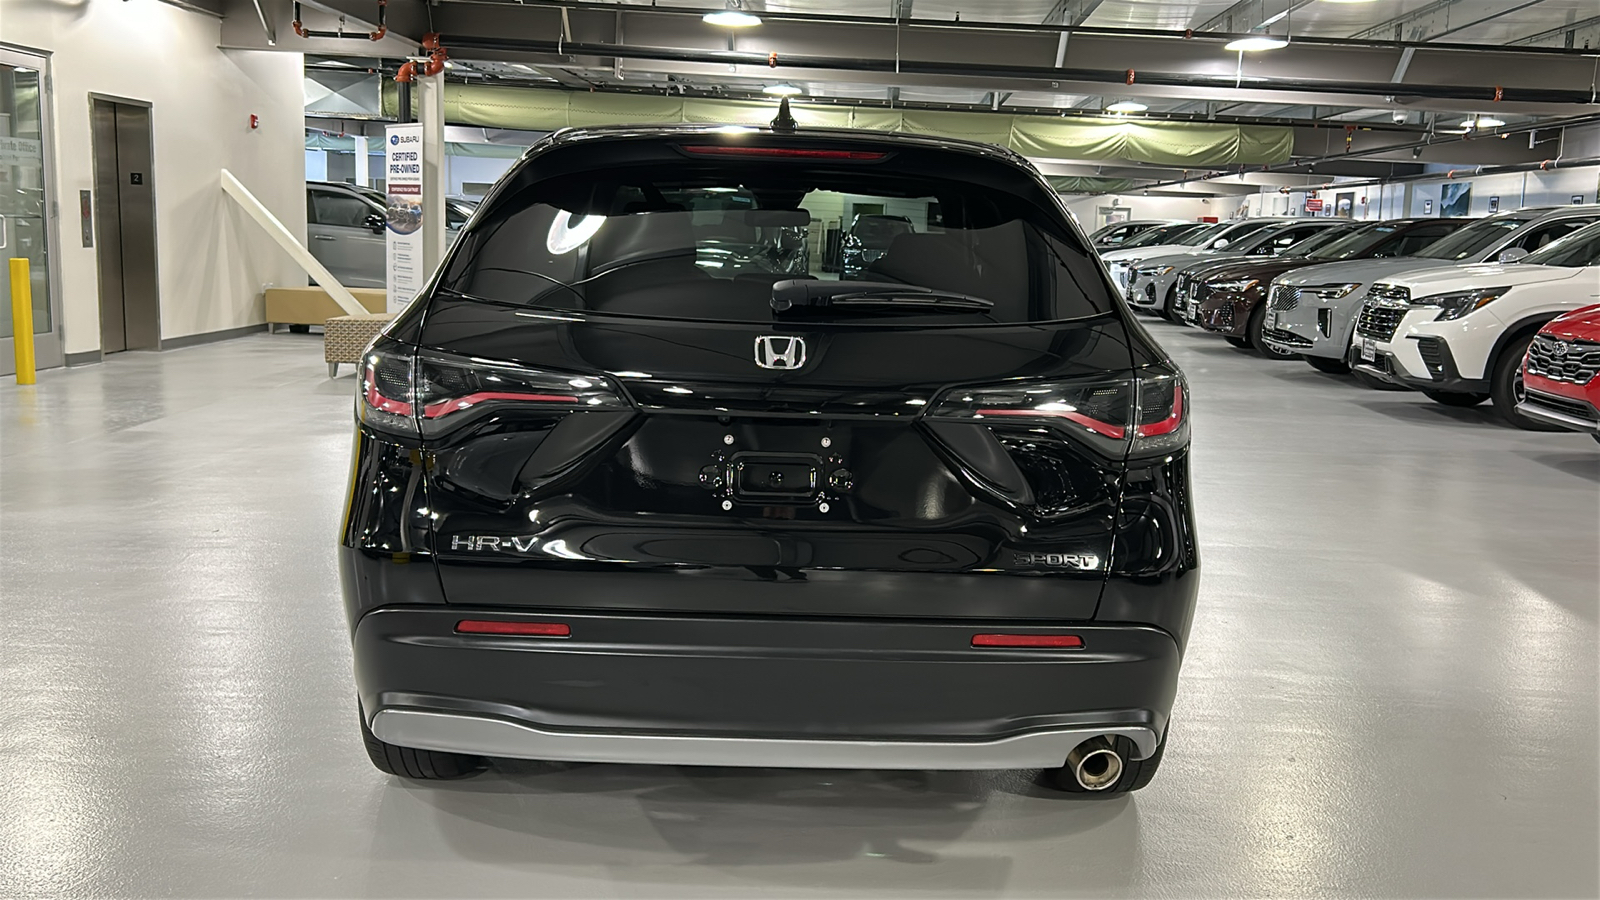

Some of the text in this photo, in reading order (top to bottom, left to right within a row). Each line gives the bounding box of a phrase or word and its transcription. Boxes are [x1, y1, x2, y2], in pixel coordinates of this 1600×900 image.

[400, 135, 419, 143] SUBARU
[18, 140, 37, 153] Office
[392, 151, 418, 161] CERTIFIED
[390, 164, 420, 174] PRE-OWNED
[133, 174, 139, 182] 2
[451, 534, 540, 552] HR-V
[1013, 553, 1099, 570] SPORT
